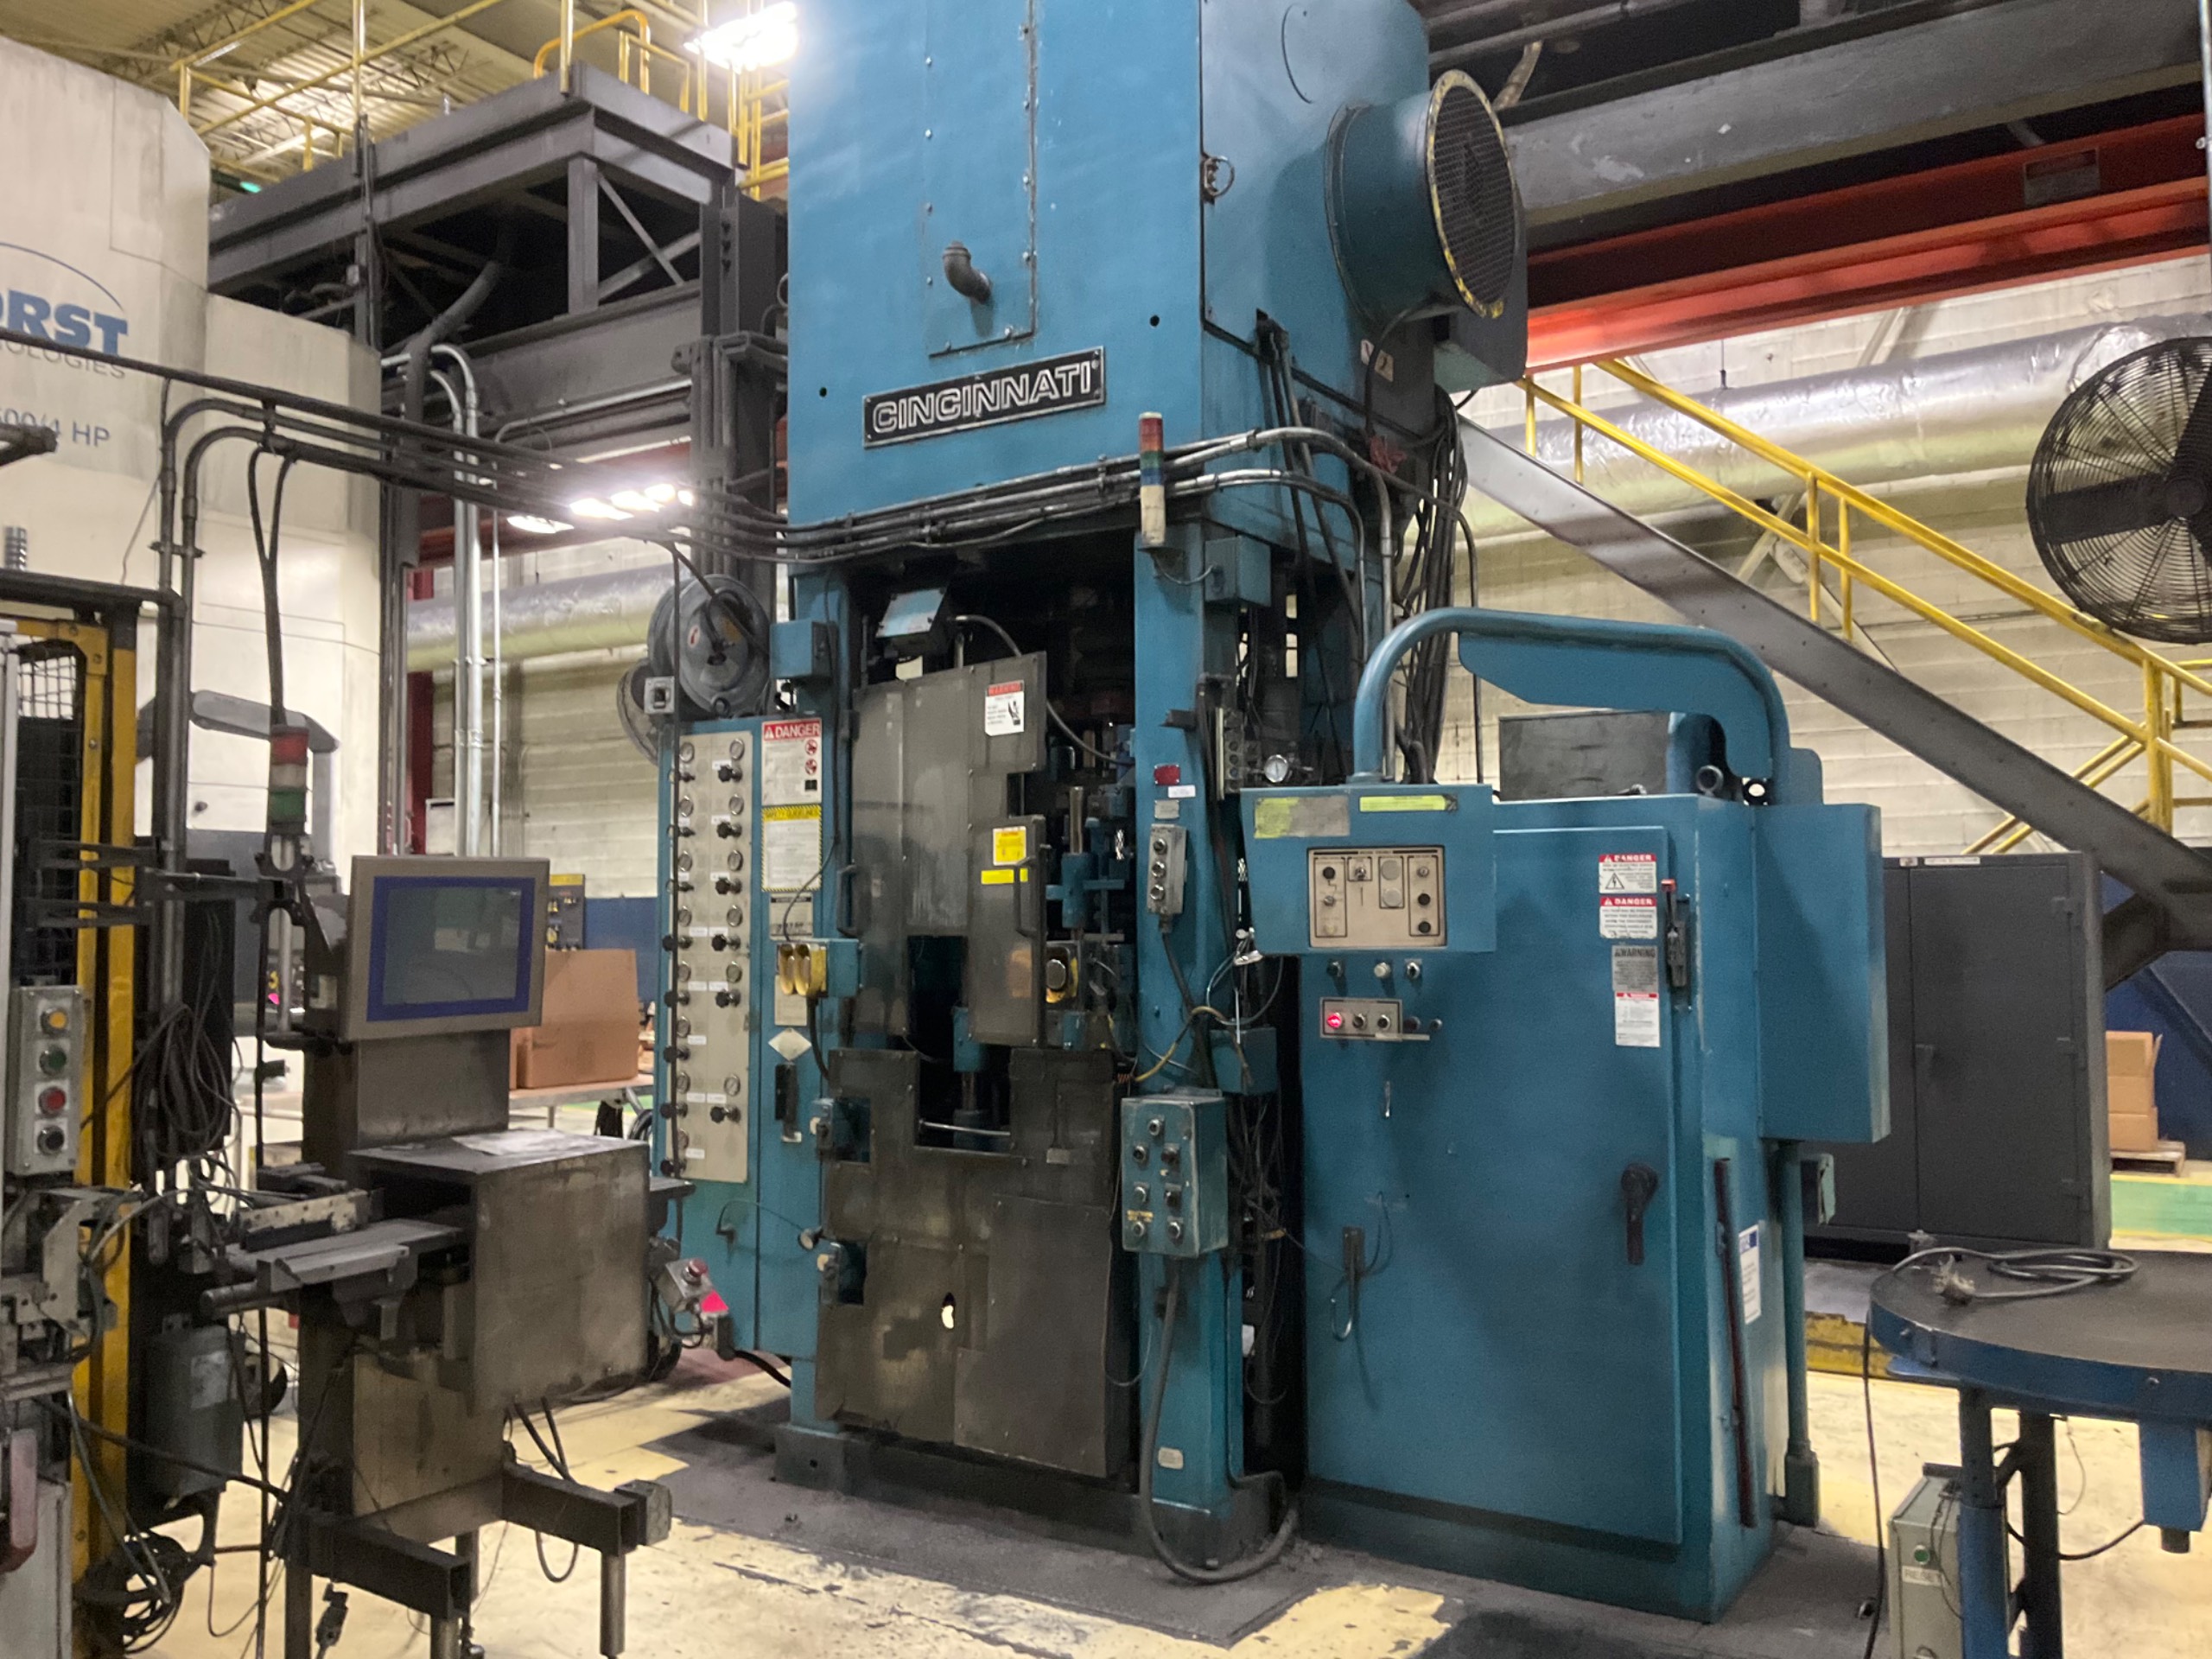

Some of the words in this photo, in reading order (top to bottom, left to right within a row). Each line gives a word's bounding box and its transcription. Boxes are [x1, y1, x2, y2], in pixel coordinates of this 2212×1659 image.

[0, 289, 128, 356] RST
[873, 360, 1091, 433] CINCINNATI
[73, 421, 111, 447] HP
[775, 723, 820, 739] DANGER
[1614, 854, 1652, 862] DANGER
[1614, 897, 1653, 906] DANGER
